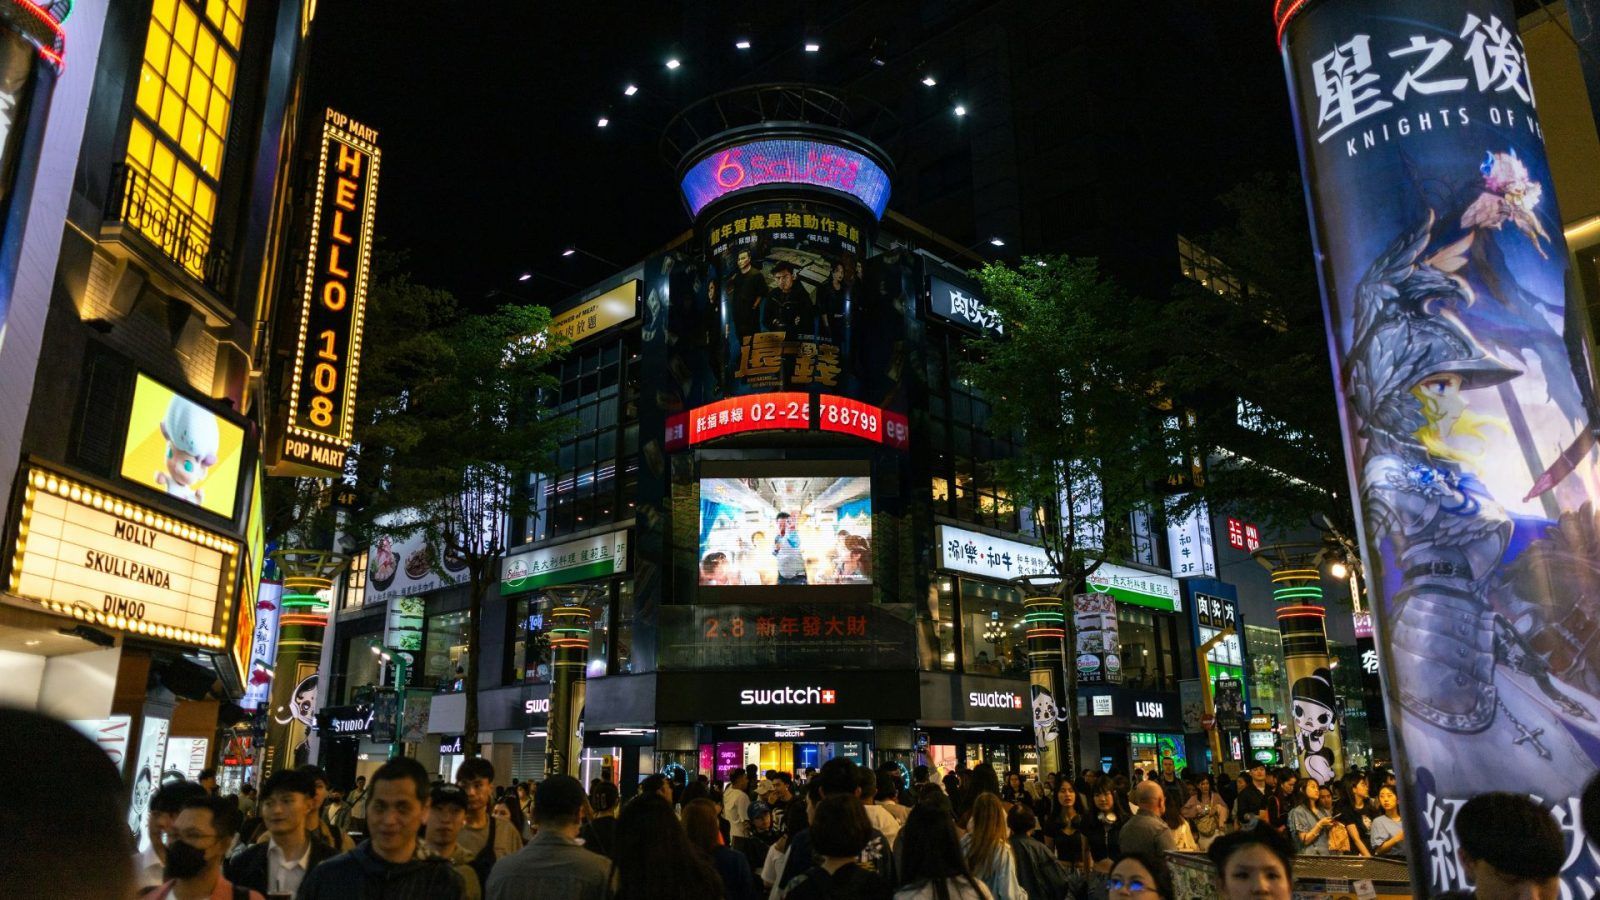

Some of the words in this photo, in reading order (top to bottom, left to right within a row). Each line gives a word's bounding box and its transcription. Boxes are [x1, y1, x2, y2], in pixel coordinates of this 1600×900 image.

[1312, 13, 1537, 143] 星之後
[326, 107, 347, 126] POP
[349, 119, 379, 144] MART
[1347, 107, 1469, 156] KNIGHTS
[1489, 107, 1514, 127] OF
[717, 149, 745, 188] 6
[323, 143, 361, 311] HELLO
[309, 329, 338, 427] 108
[285, 440, 310, 459] POP
[312, 446, 345, 468] MART
[115, 520, 157, 549] MOLLY
[85, 550, 170, 590] SKULLPANDA
[1181, 563, 1195, 573] 3F
[102, 594, 146, 619] DIMOO
[1197, 596, 1235, 623] 肉次方
[755, 616, 868, 637] 新年發大財
[525, 699, 549, 713] swa
[740, 686, 821, 705] swatch
[969, 691, 1013, 709] swatch
[1136, 701, 1164, 719] LUSH
[335, 719, 363, 732] STUDIO
